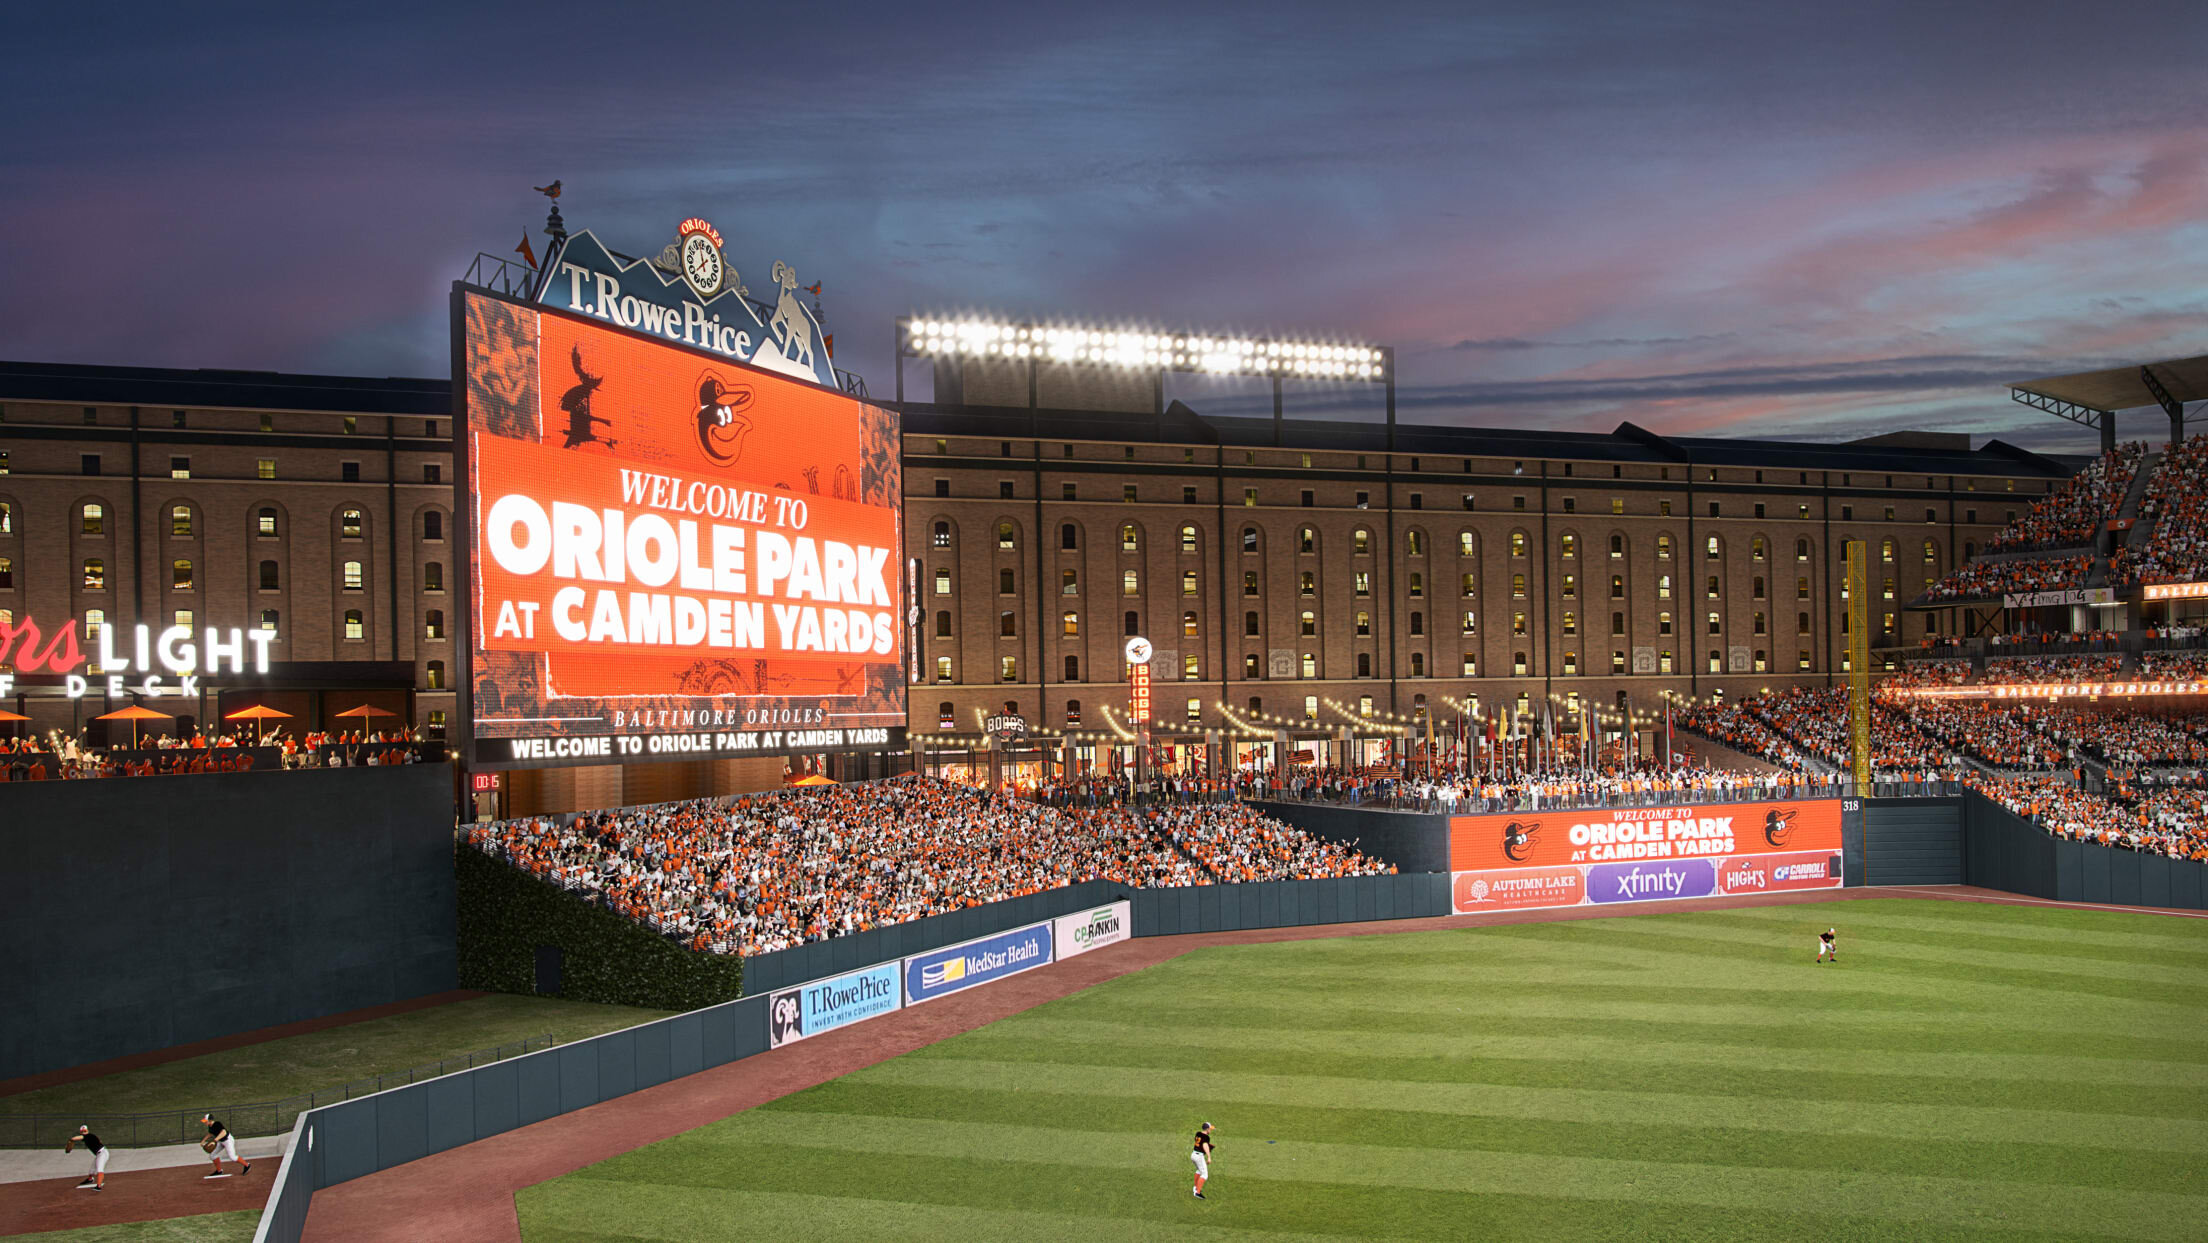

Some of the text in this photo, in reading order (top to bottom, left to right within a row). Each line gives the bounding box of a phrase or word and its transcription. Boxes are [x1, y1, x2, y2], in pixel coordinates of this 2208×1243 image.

[681, 218, 723, 247] ORIOLES
[619, 468, 808, 530] WELCOME TO
[487, 493, 747, 594] ORIOLE
[756, 530, 892, 607] PARK
[493, 600, 540, 640] AT
[552, 585, 765, 649] CAMDEN
[772, 602, 894, 655] YARDS
[98, 622, 278, 674] LIGHT
[66, 674, 202, 698] DECK
[1995, 682, 2201, 697] BALTIMORE ORIOLES
[614, 708, 824, 728] BALTIMORE ORIOLES
[511, 728, 889, 760] WELCOME TO ORIOLE PARK AT CAMDEN YARDS
[1613, 808, 1693, 822] WELCOME TO
[1843, 800, 1859, 812] 318
[1569, 816, 1735, 846] ORIOLE PARK
[1571, 837, 1736, 862] AT CAMDEN YARDS
[1617, 866, 1687, 898] xfinity
[1726, 870, 1766, 890] HIGH'S
[1790, 862, 1827, 875] CARROLL
[1492, 875, 1577, 892] AUTUMN LAKE
[966, 937, 1040, 976] MedStar Health
[811, 999, 892, 1030] INVEST WITH CONFIDENCE
